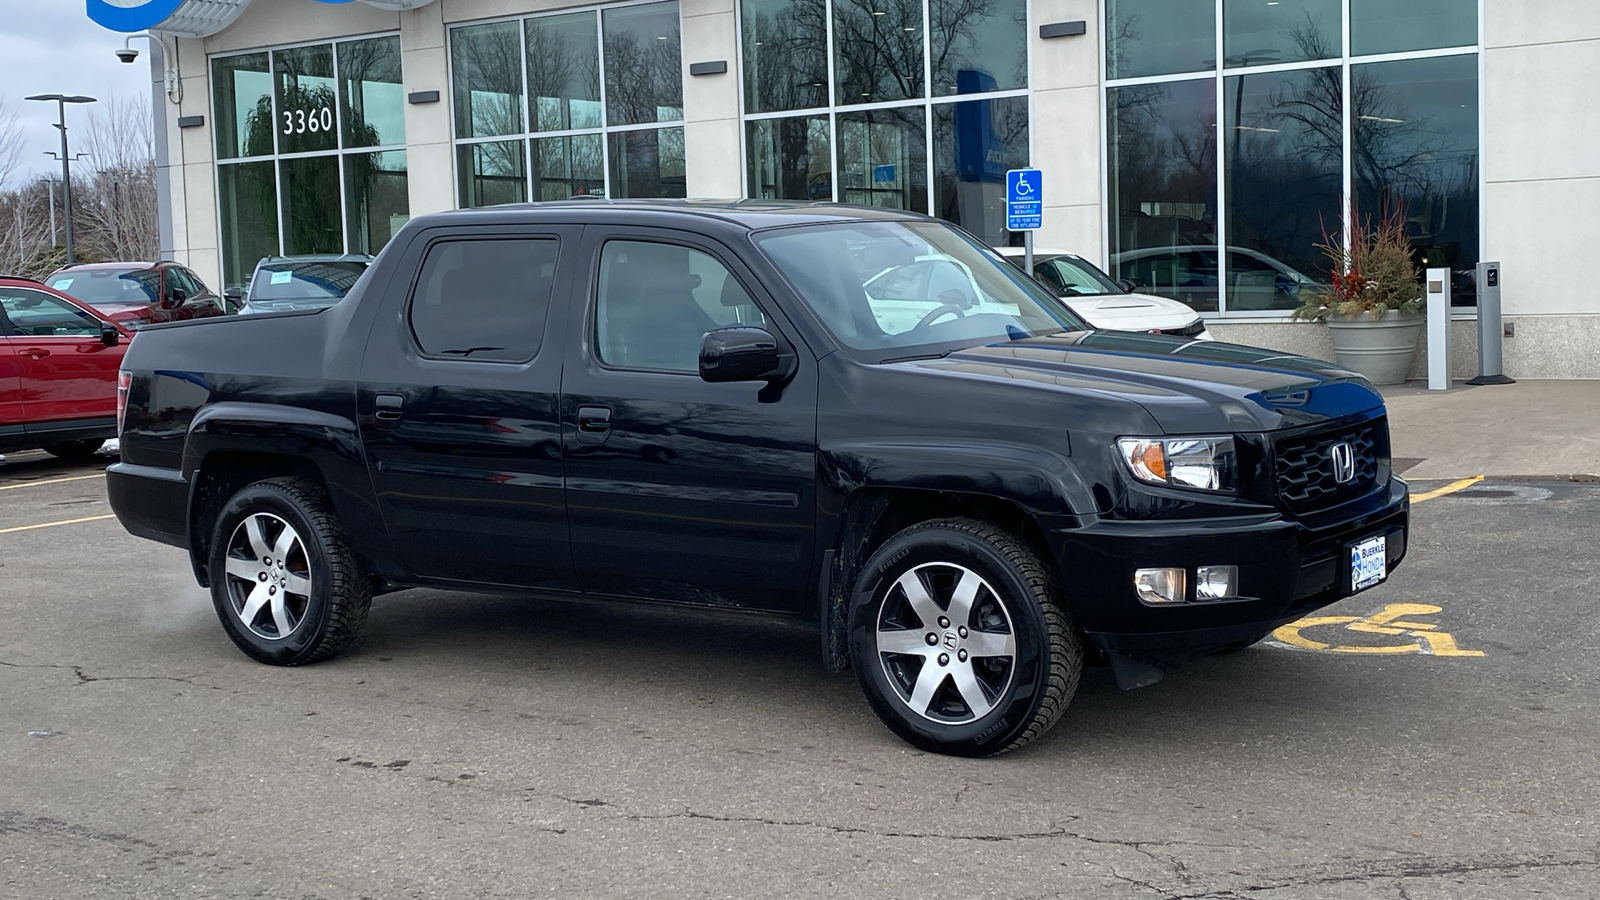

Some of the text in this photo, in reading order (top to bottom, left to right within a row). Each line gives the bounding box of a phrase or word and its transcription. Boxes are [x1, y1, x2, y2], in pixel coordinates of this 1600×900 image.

[283, 107, 332, 135] 3360
[879, 548, 910, 572] PIRELLI
[1361, 543, 1385, 559] BUERKLE
[1362, 556, 1385, 576] HONDA
